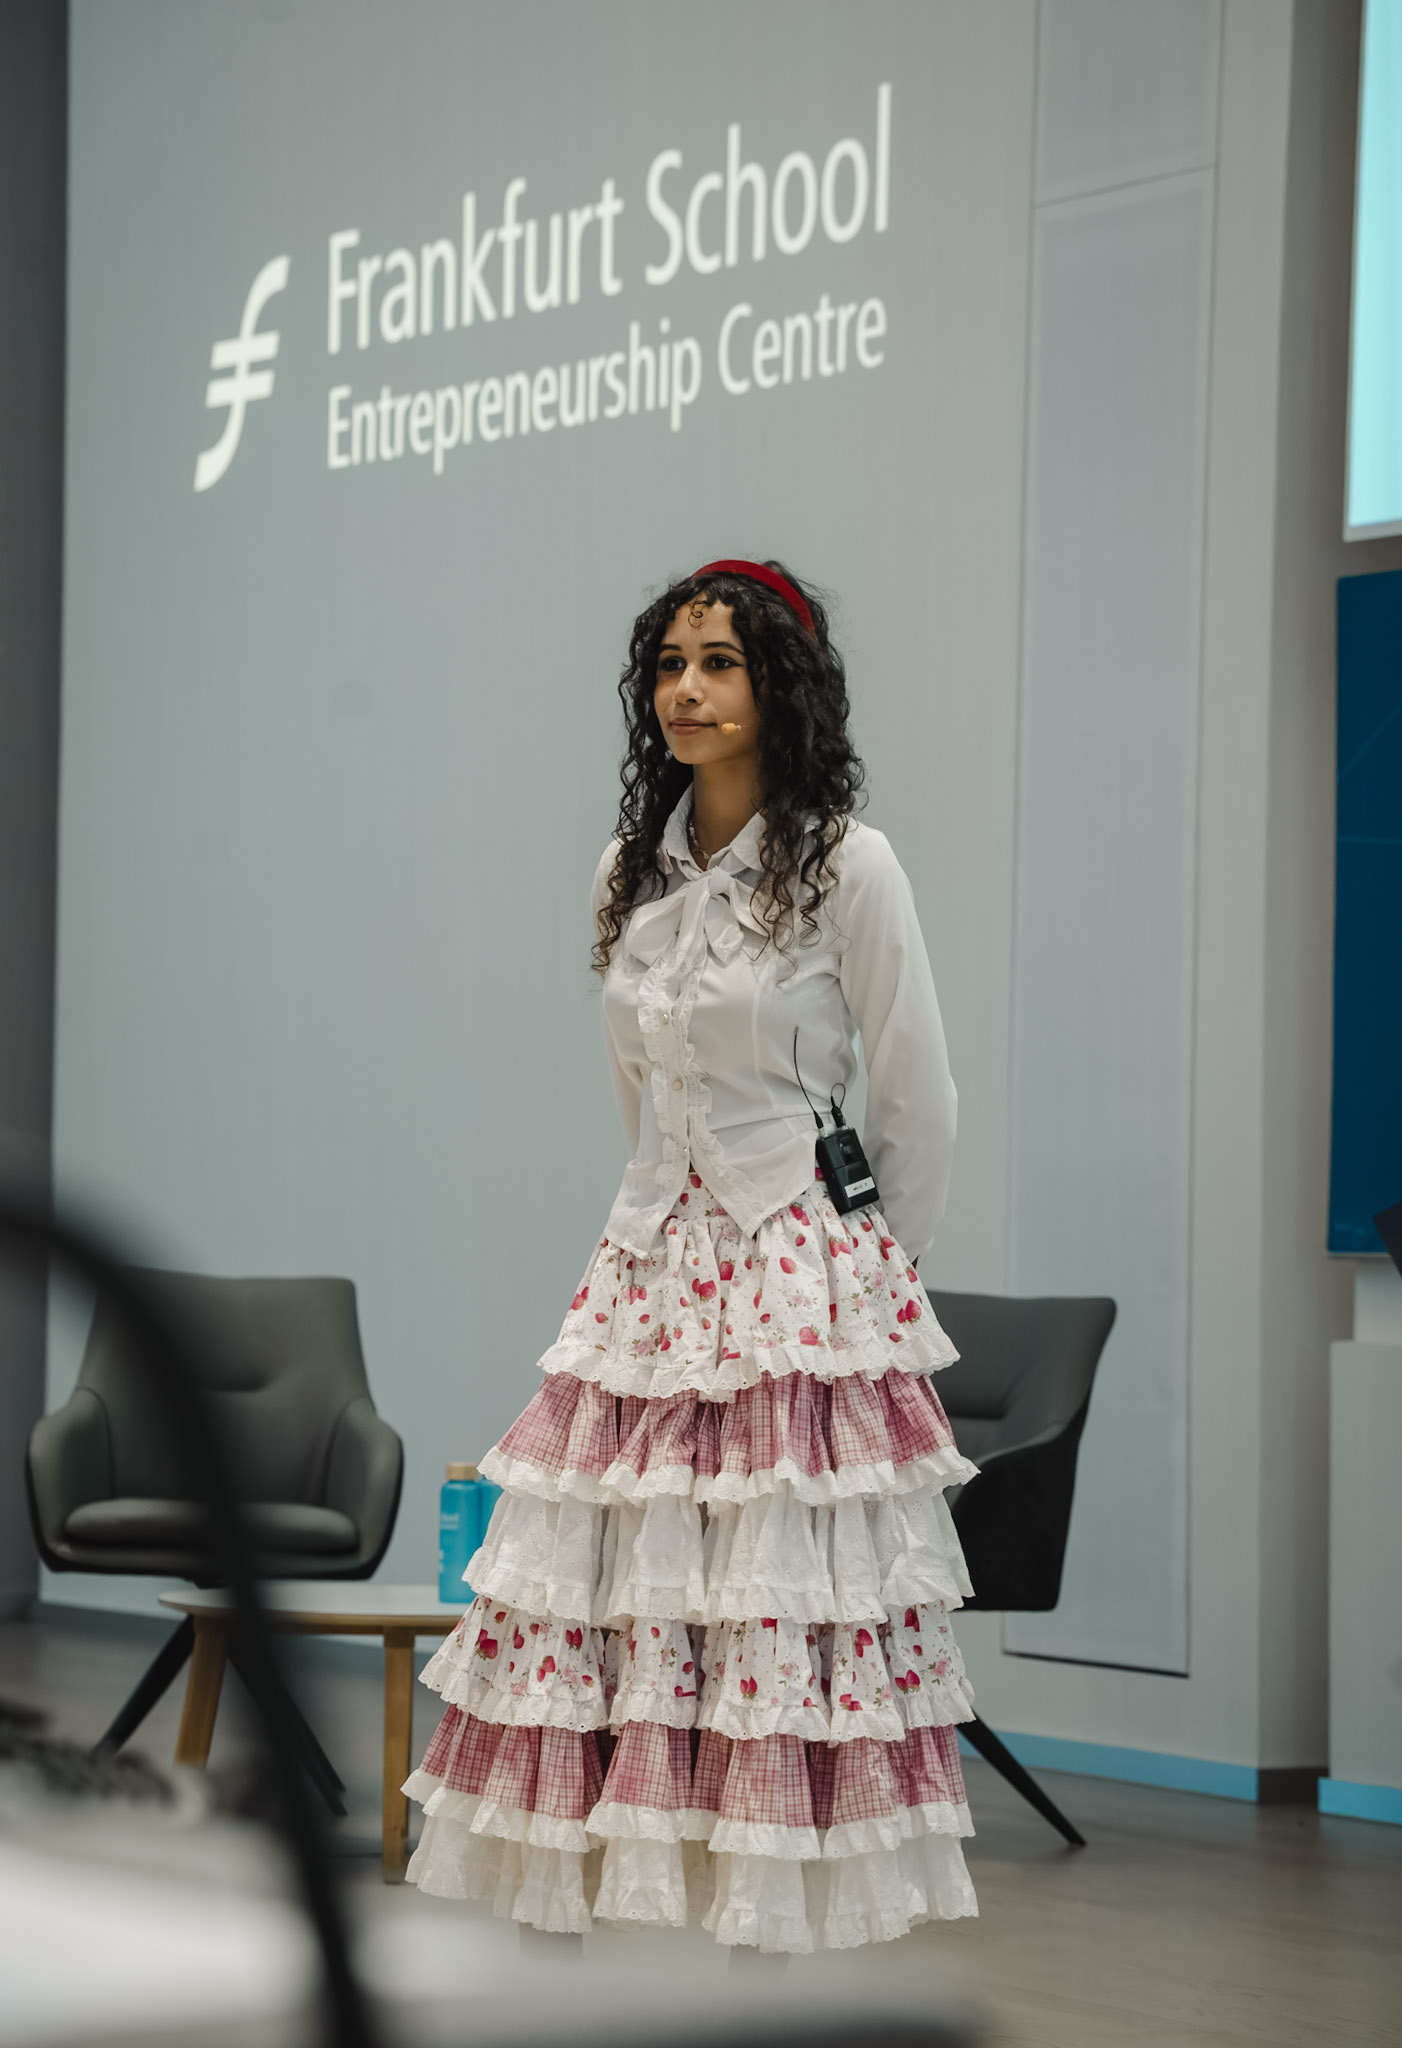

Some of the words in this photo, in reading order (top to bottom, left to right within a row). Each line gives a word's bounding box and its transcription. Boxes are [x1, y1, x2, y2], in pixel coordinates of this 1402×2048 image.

[327, 177, 624, 354] Frankfurt
[645, 81, 893, 286] School
[327, 318, 702, 475] Entrepreneurship
[718, 294, 888, 396] Centre
